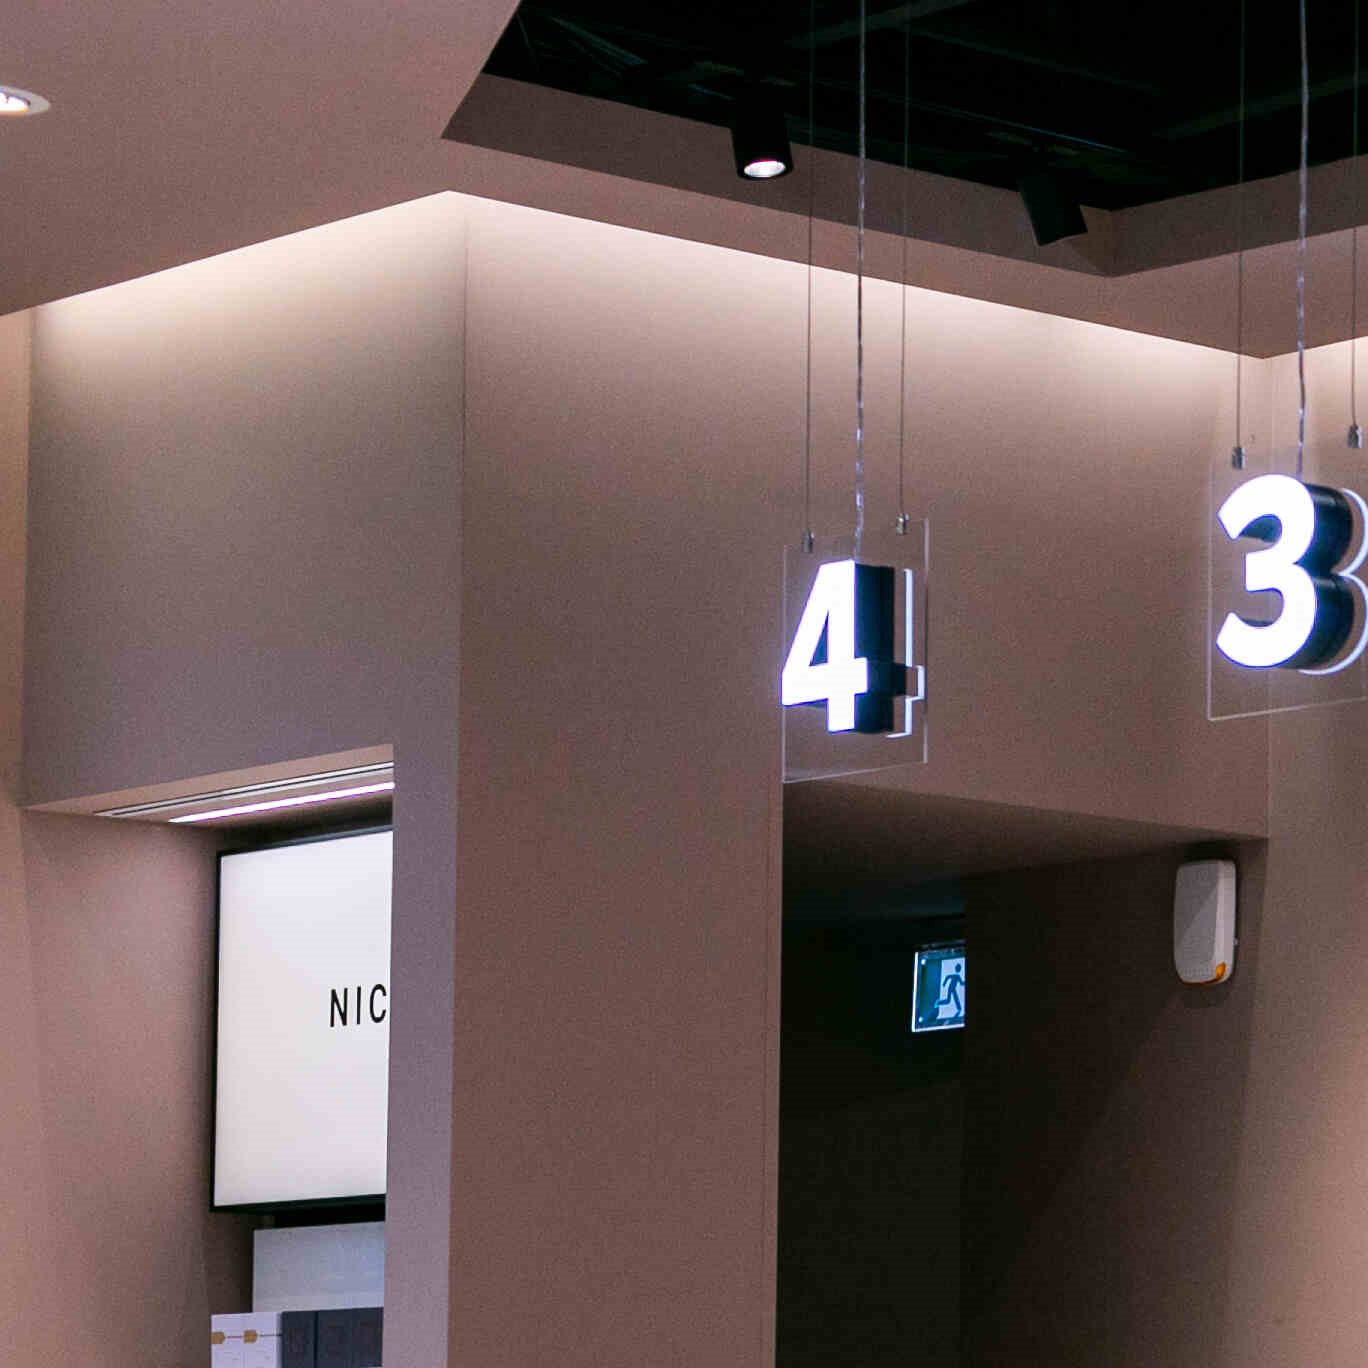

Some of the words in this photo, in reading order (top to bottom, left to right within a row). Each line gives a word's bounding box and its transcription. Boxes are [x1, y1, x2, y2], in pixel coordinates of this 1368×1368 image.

[780, 558, 870, 733] 4
[1215, 472, 1319, 669] 3
[329, 983, 387, 1027] NIC
